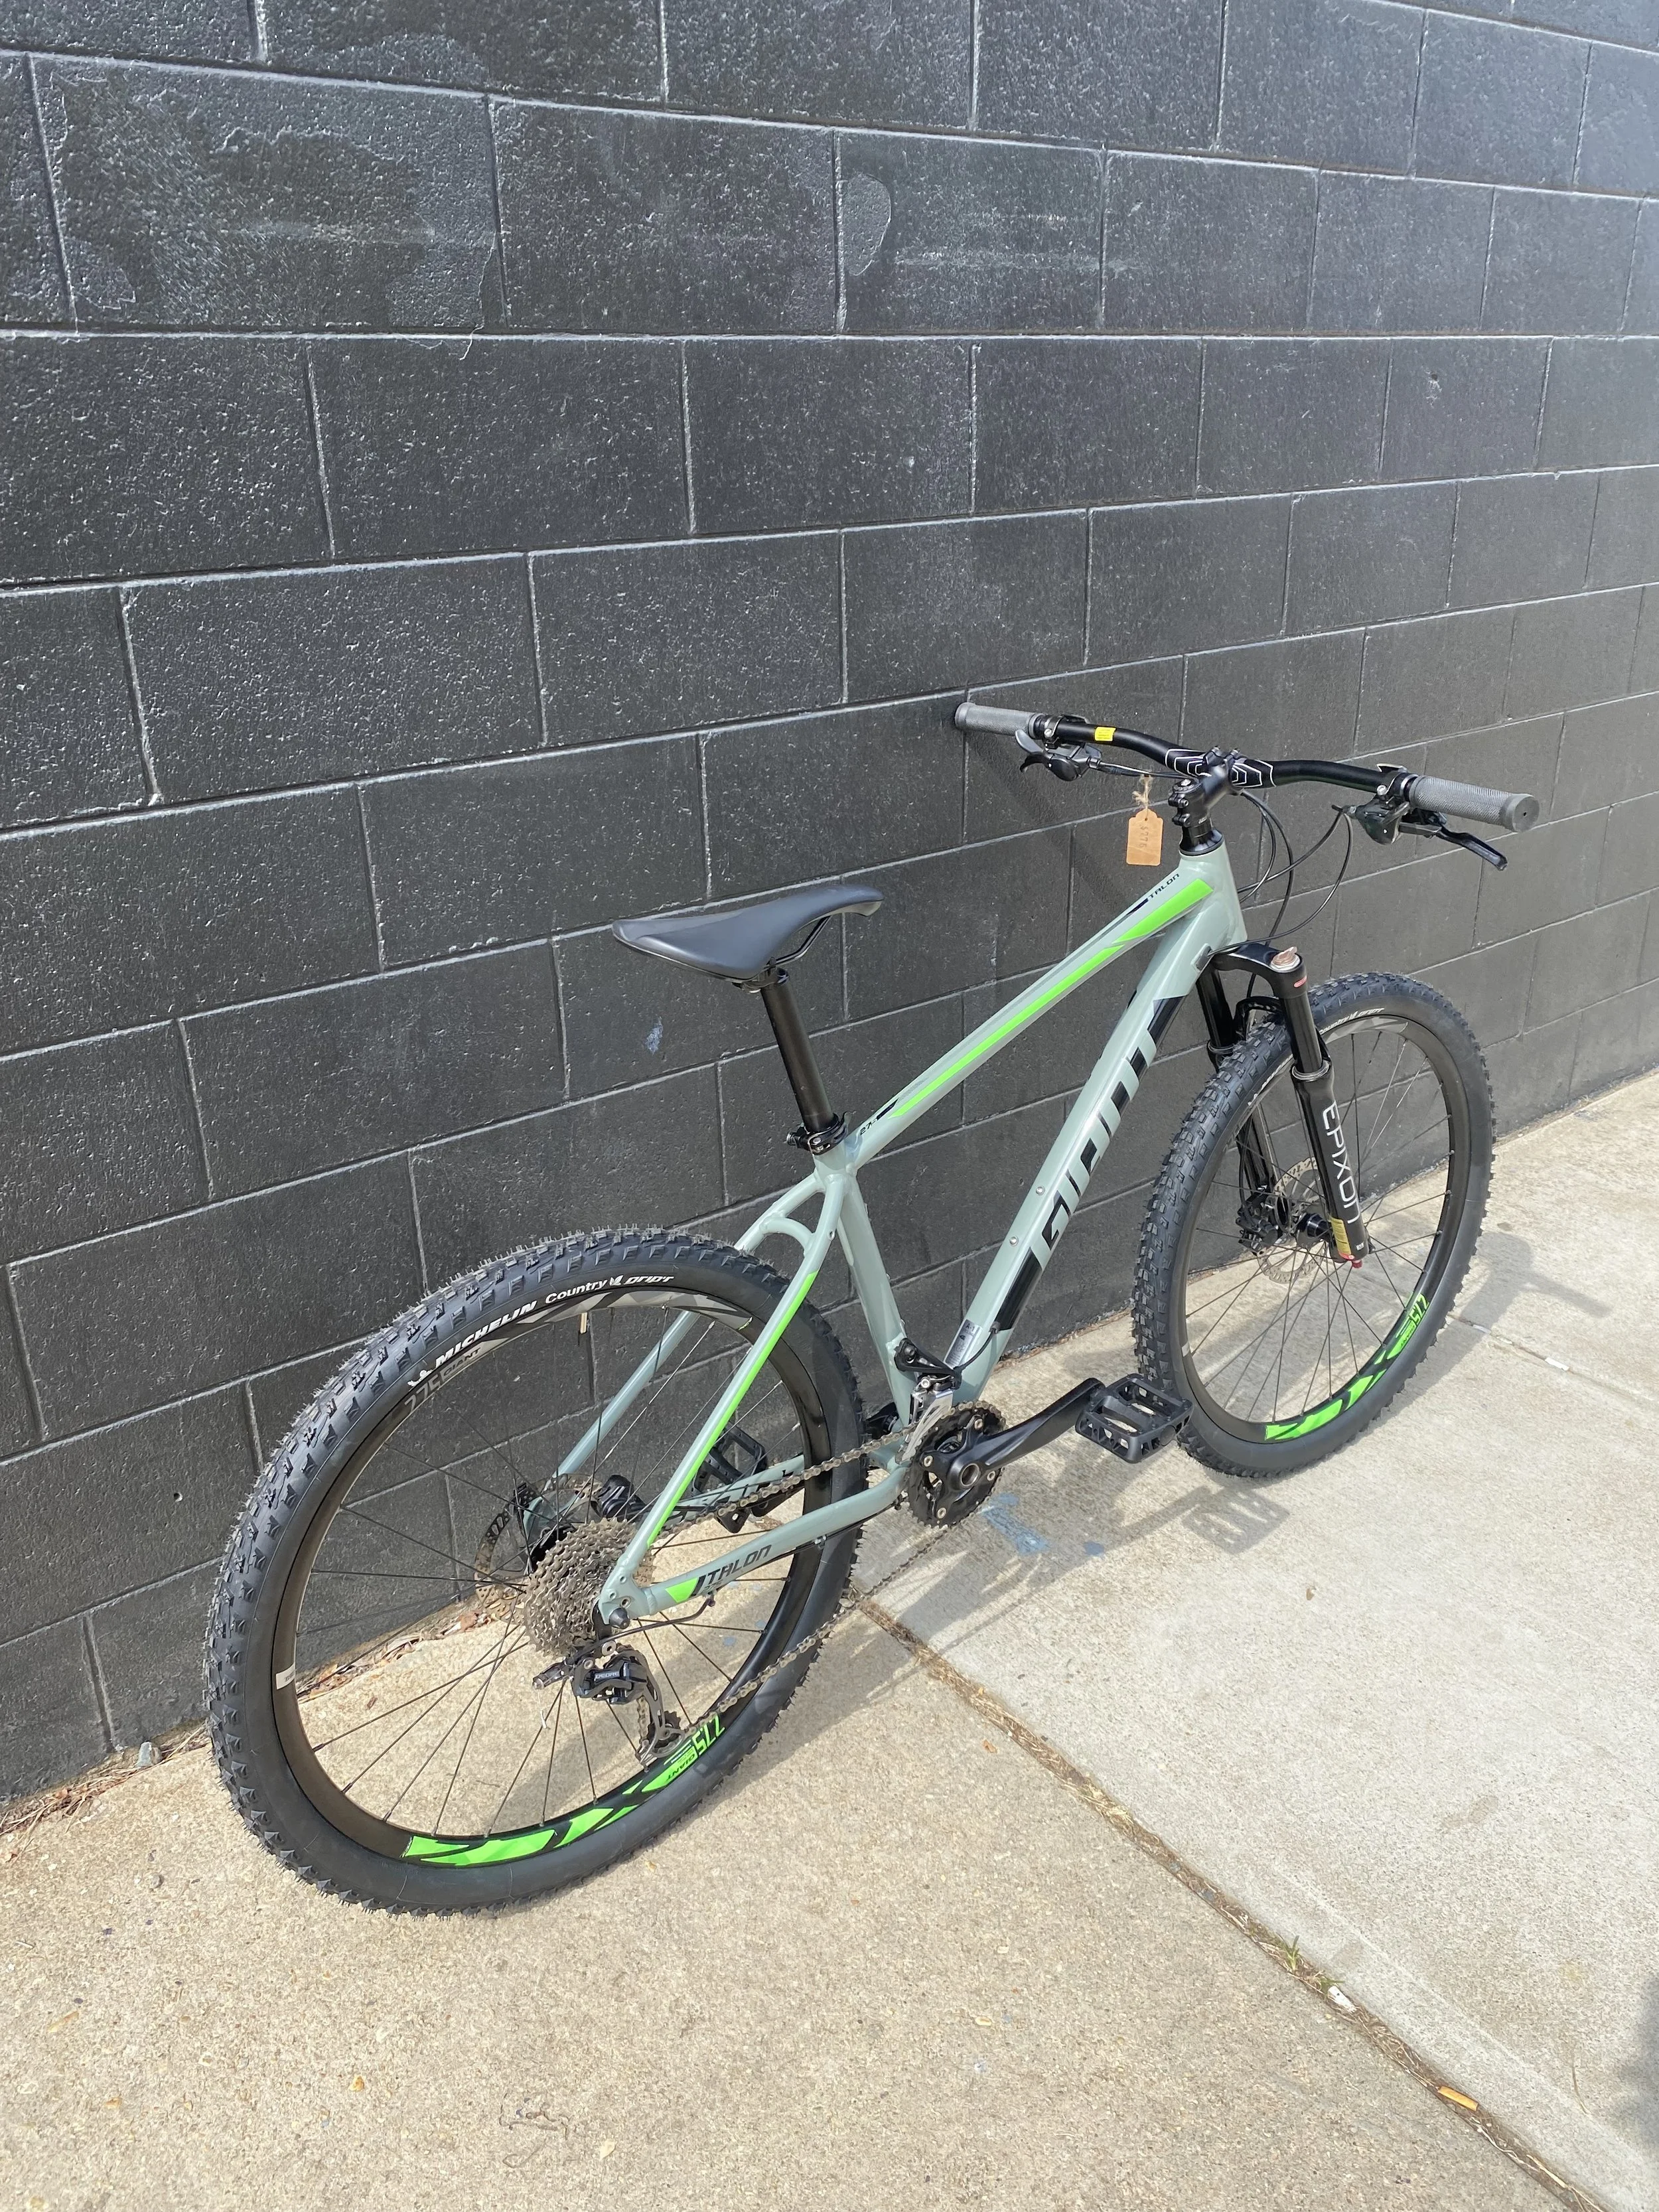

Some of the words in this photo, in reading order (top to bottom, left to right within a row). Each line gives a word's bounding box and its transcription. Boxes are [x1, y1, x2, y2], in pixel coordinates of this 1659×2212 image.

[1148, 873, 1179, 899] TALON
[435, 1300, 538, 1368] MICHELIN
[545, 1280, 607, 1304] Country
[444, 1347, 481, 1376] GIANT
[707, 1544, 772, 1585] TALON
[667, 1753, 695, 1781] GIANT
